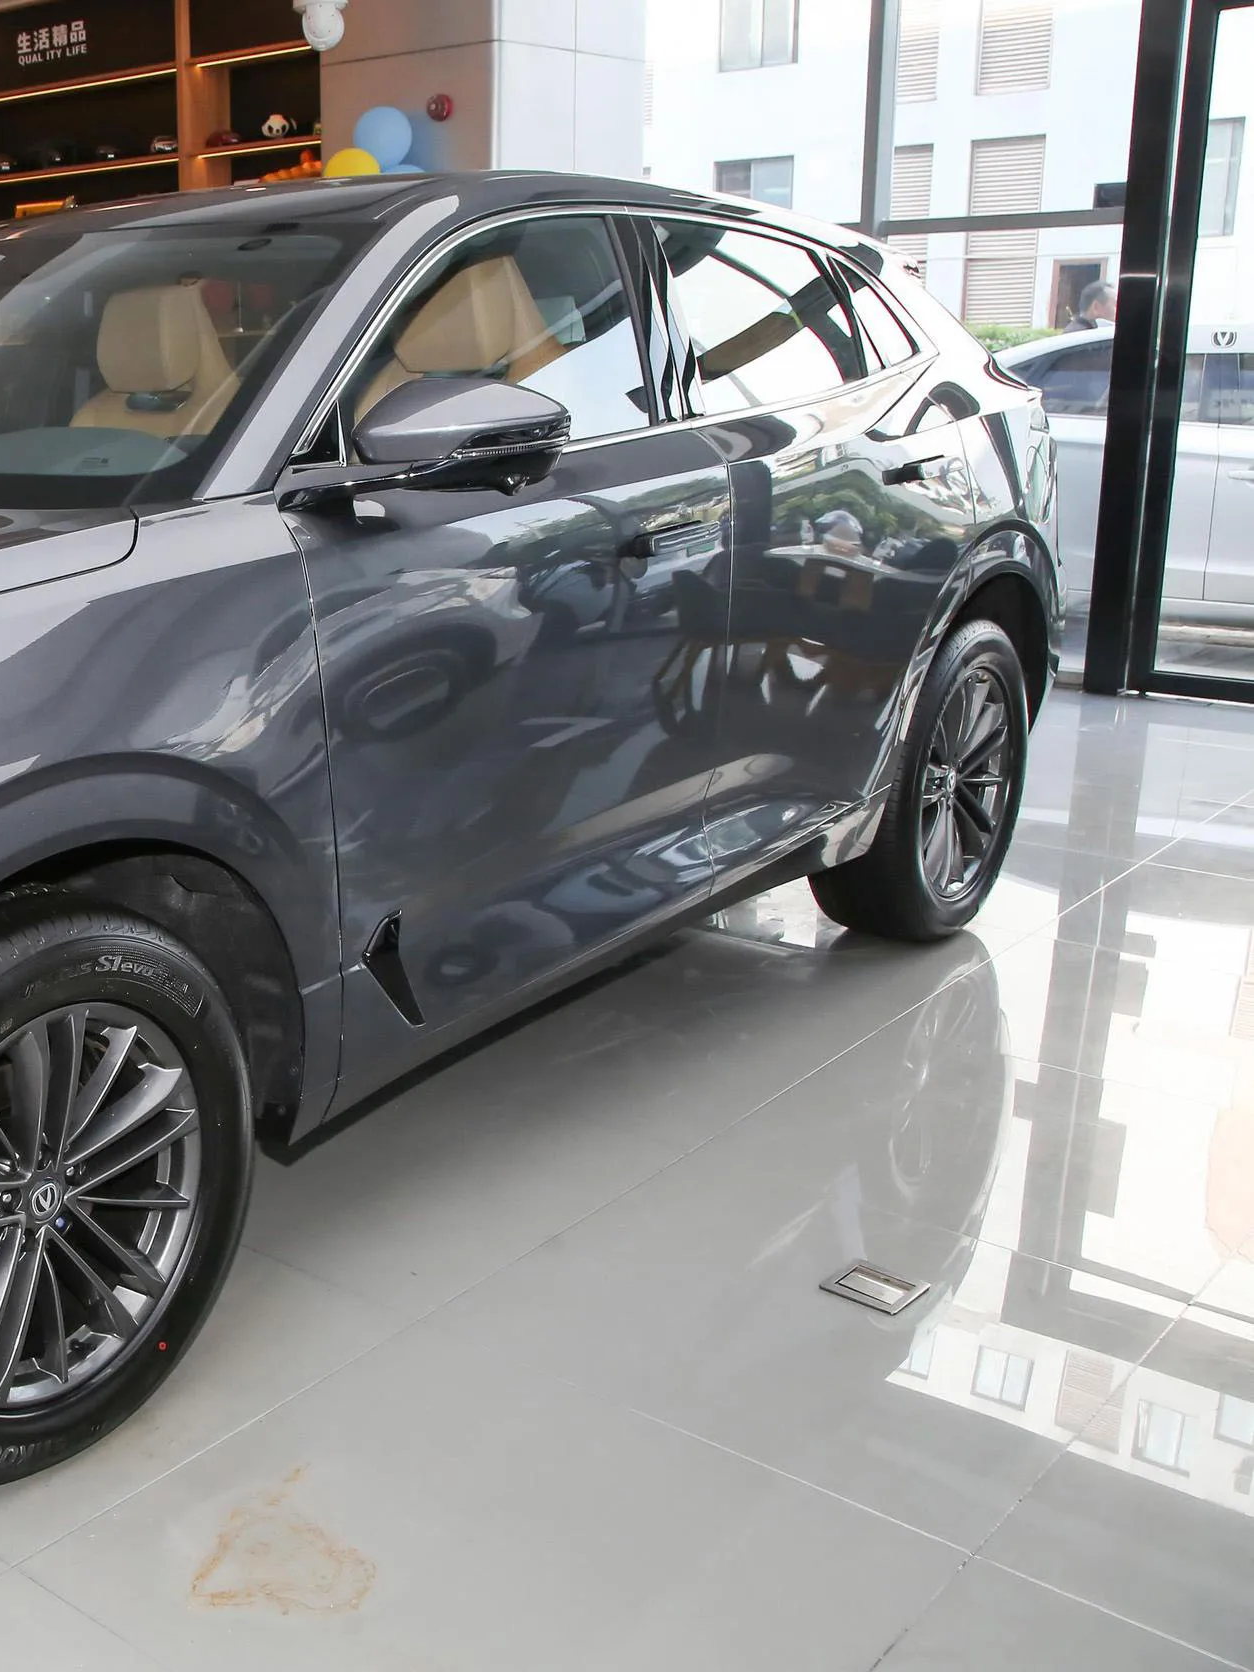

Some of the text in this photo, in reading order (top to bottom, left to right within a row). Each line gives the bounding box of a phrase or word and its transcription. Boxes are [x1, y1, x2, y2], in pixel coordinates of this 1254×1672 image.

[17, 20, 86, 54] 生活精品
[66, 43, 88, 57] LIFE
